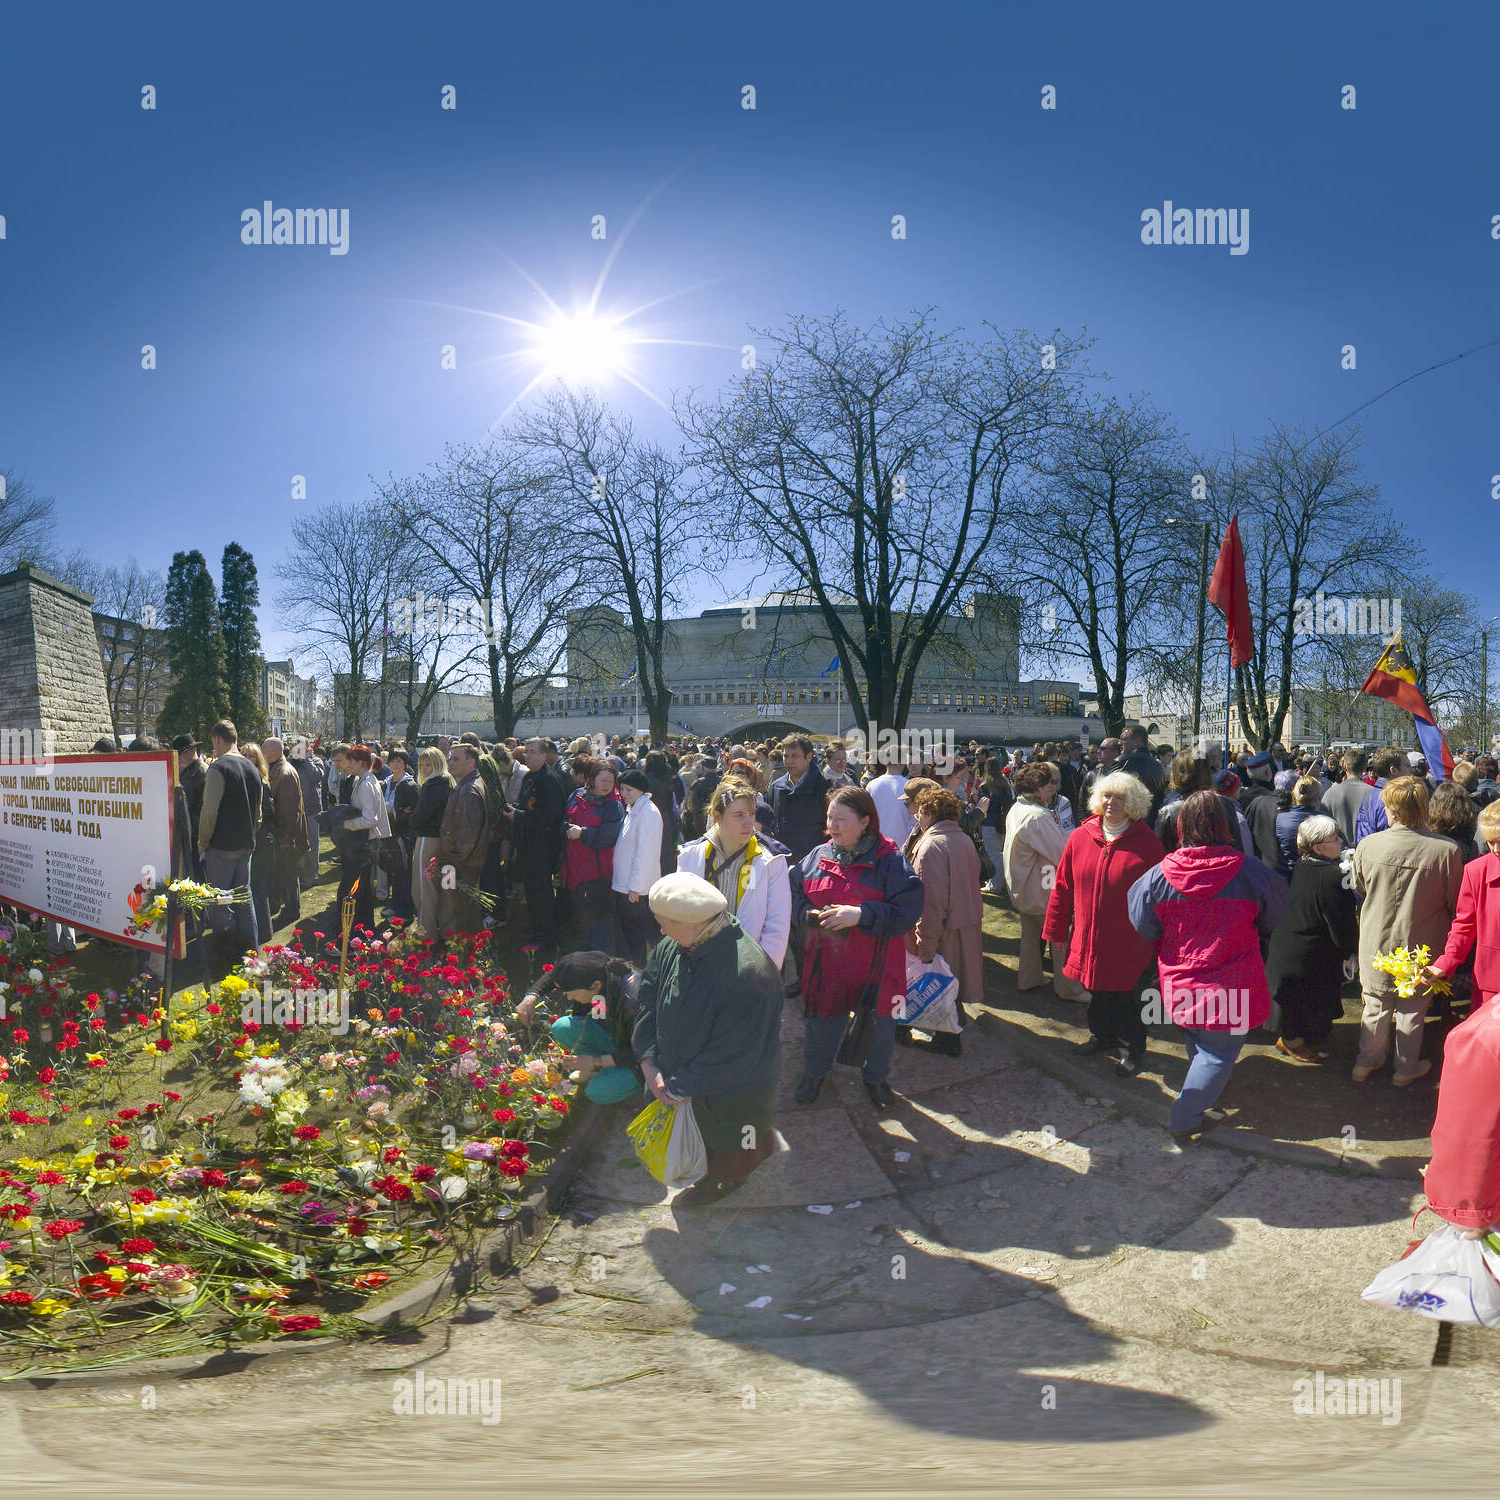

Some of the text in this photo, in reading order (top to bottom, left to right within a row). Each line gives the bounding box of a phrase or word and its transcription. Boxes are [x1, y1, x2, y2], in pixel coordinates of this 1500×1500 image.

[20, 776, 50, 791] ПАМЯТЬ
[54, 776, 142, 794] ОСВОБОДИТЕЛЯМ
[3, 793, 142, 820] ГОРОДА ТАЛЛИННА, ПОГИБШИМ
[3, 811, 101, 840] В СЕНТЯБРЕ 1944 ГОДА
